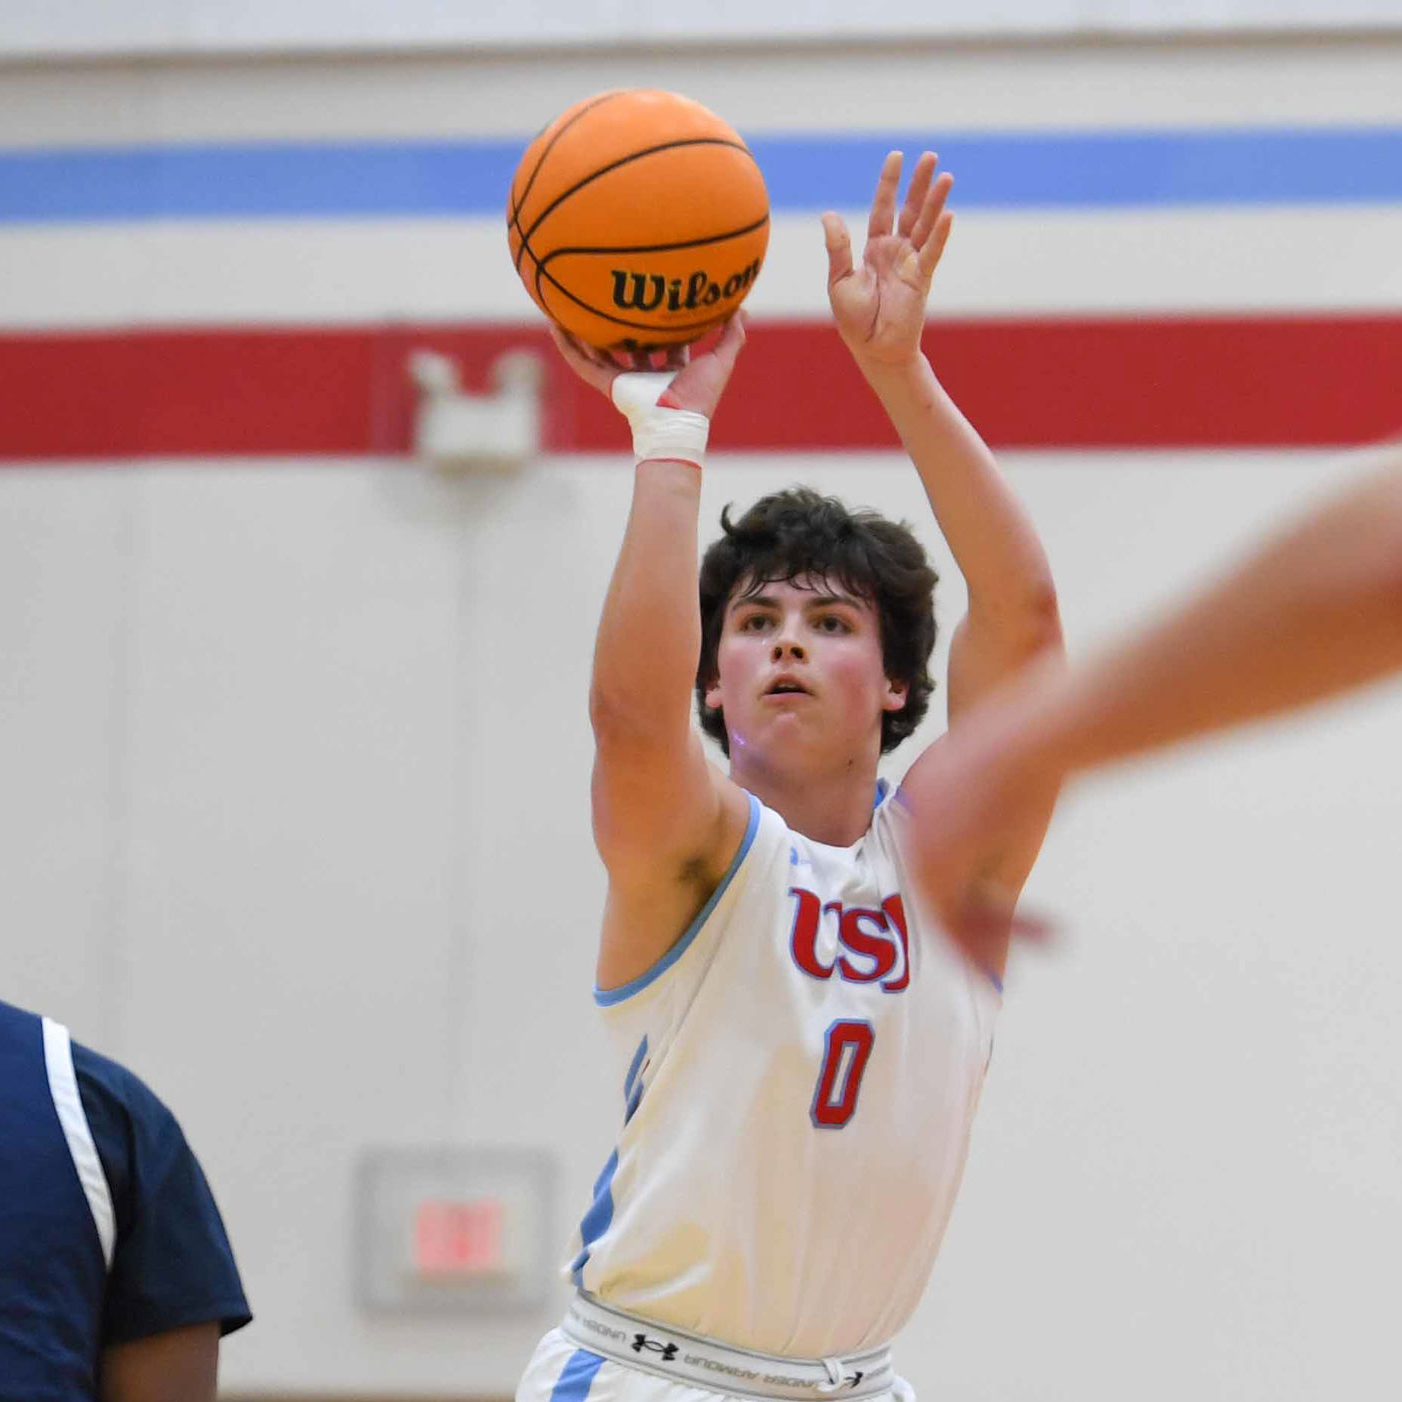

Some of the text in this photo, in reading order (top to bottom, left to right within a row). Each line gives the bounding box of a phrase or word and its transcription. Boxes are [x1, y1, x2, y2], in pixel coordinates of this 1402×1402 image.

[611, 257, 760, 311] Wilson
[810, 1018, 876, 1130] 0
[684, 1353, 760, 1379] ARMOUR
